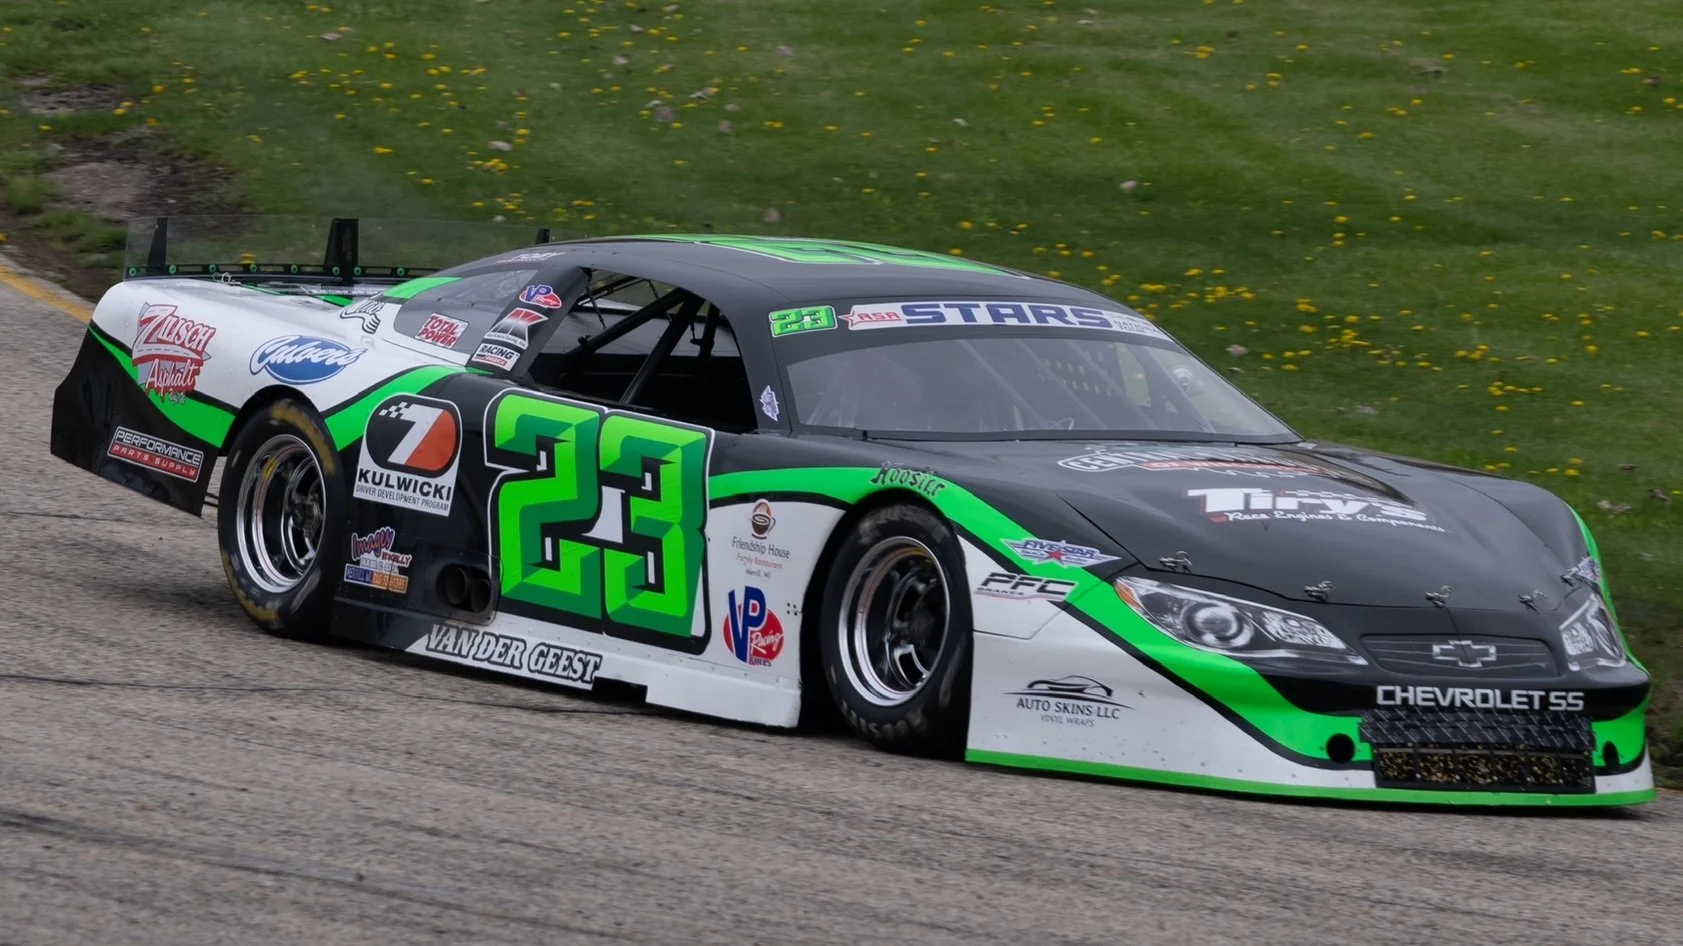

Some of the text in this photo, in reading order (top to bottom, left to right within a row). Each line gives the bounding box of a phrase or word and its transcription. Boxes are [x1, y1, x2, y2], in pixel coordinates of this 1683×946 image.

[424, 315, 460, 335] TOTAL
[769, 306, 838, 337] 23
[859, 311, 900, 321] ASA
[901, 303, 1113, 328] STARS
[133, 303, 216, 360] ZUSCH
[418, 329, 457, 347] POWER
[479, 345, 515, 360] RACING
[145, 358, 201, 400] Asphalt
[378, 401, 445, 465] 7
[112, 444, 150, 461] PARTS
[114, 430, 202, 465] PERFORMANCE
[154, 457, 197, 476] SUPPLY
[355, 483, 450, 512] DRIVER DEVELOPMENT PROGRAM
[358, 468, 452, 502] KULWICKI
[494, 393, 707, 640] 23
[1227, 511, 1270, 522] Race
[1272, 510, 1333, 523] Engines
[1357, 512, 1448, 534] Components
[731, 536, 791, 559] Friendship House
[1022, 539, 1057, 552] FIVE
[980, 570, 1077, 596] PFC
[727, 585, 768, 665] VP
[427, 623, 603, 685] VAN DER GEEST
[750, 630, 784, 655] Racing
[1016, 697, 1122, 720] AUTO SKINS LLC
[1376, 685, 1585, 711] CHEVROLET SS
